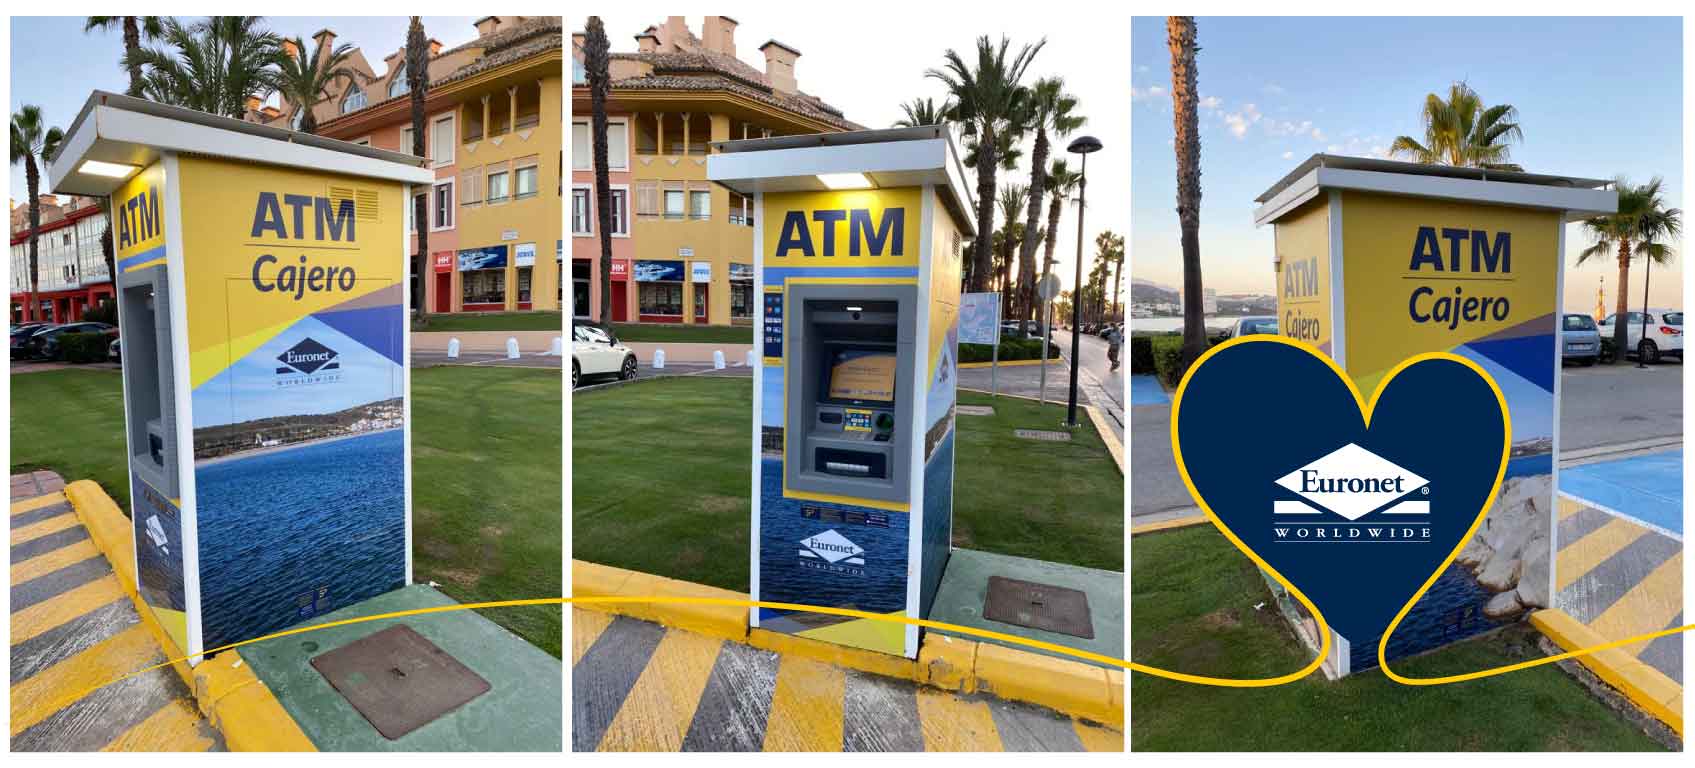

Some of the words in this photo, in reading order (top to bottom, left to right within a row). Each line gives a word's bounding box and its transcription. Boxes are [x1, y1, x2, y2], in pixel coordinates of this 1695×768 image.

[120, 185, 161, 251] ATM
[251, 191, 355, 242] ATM
[775, 207, 905, 257] ATM
[1409, 226, 1512, 273] ATM
[252, 254, 356, 301] Cajero
[1284, 255, 1319, 298] ATM
[1285, 309, 1320, 341] Cajero
[1409, 286, 1510, 330] Cajero
[287, 351, 330, 363] Euronet
[809, 538, 855, 554] Euronet
